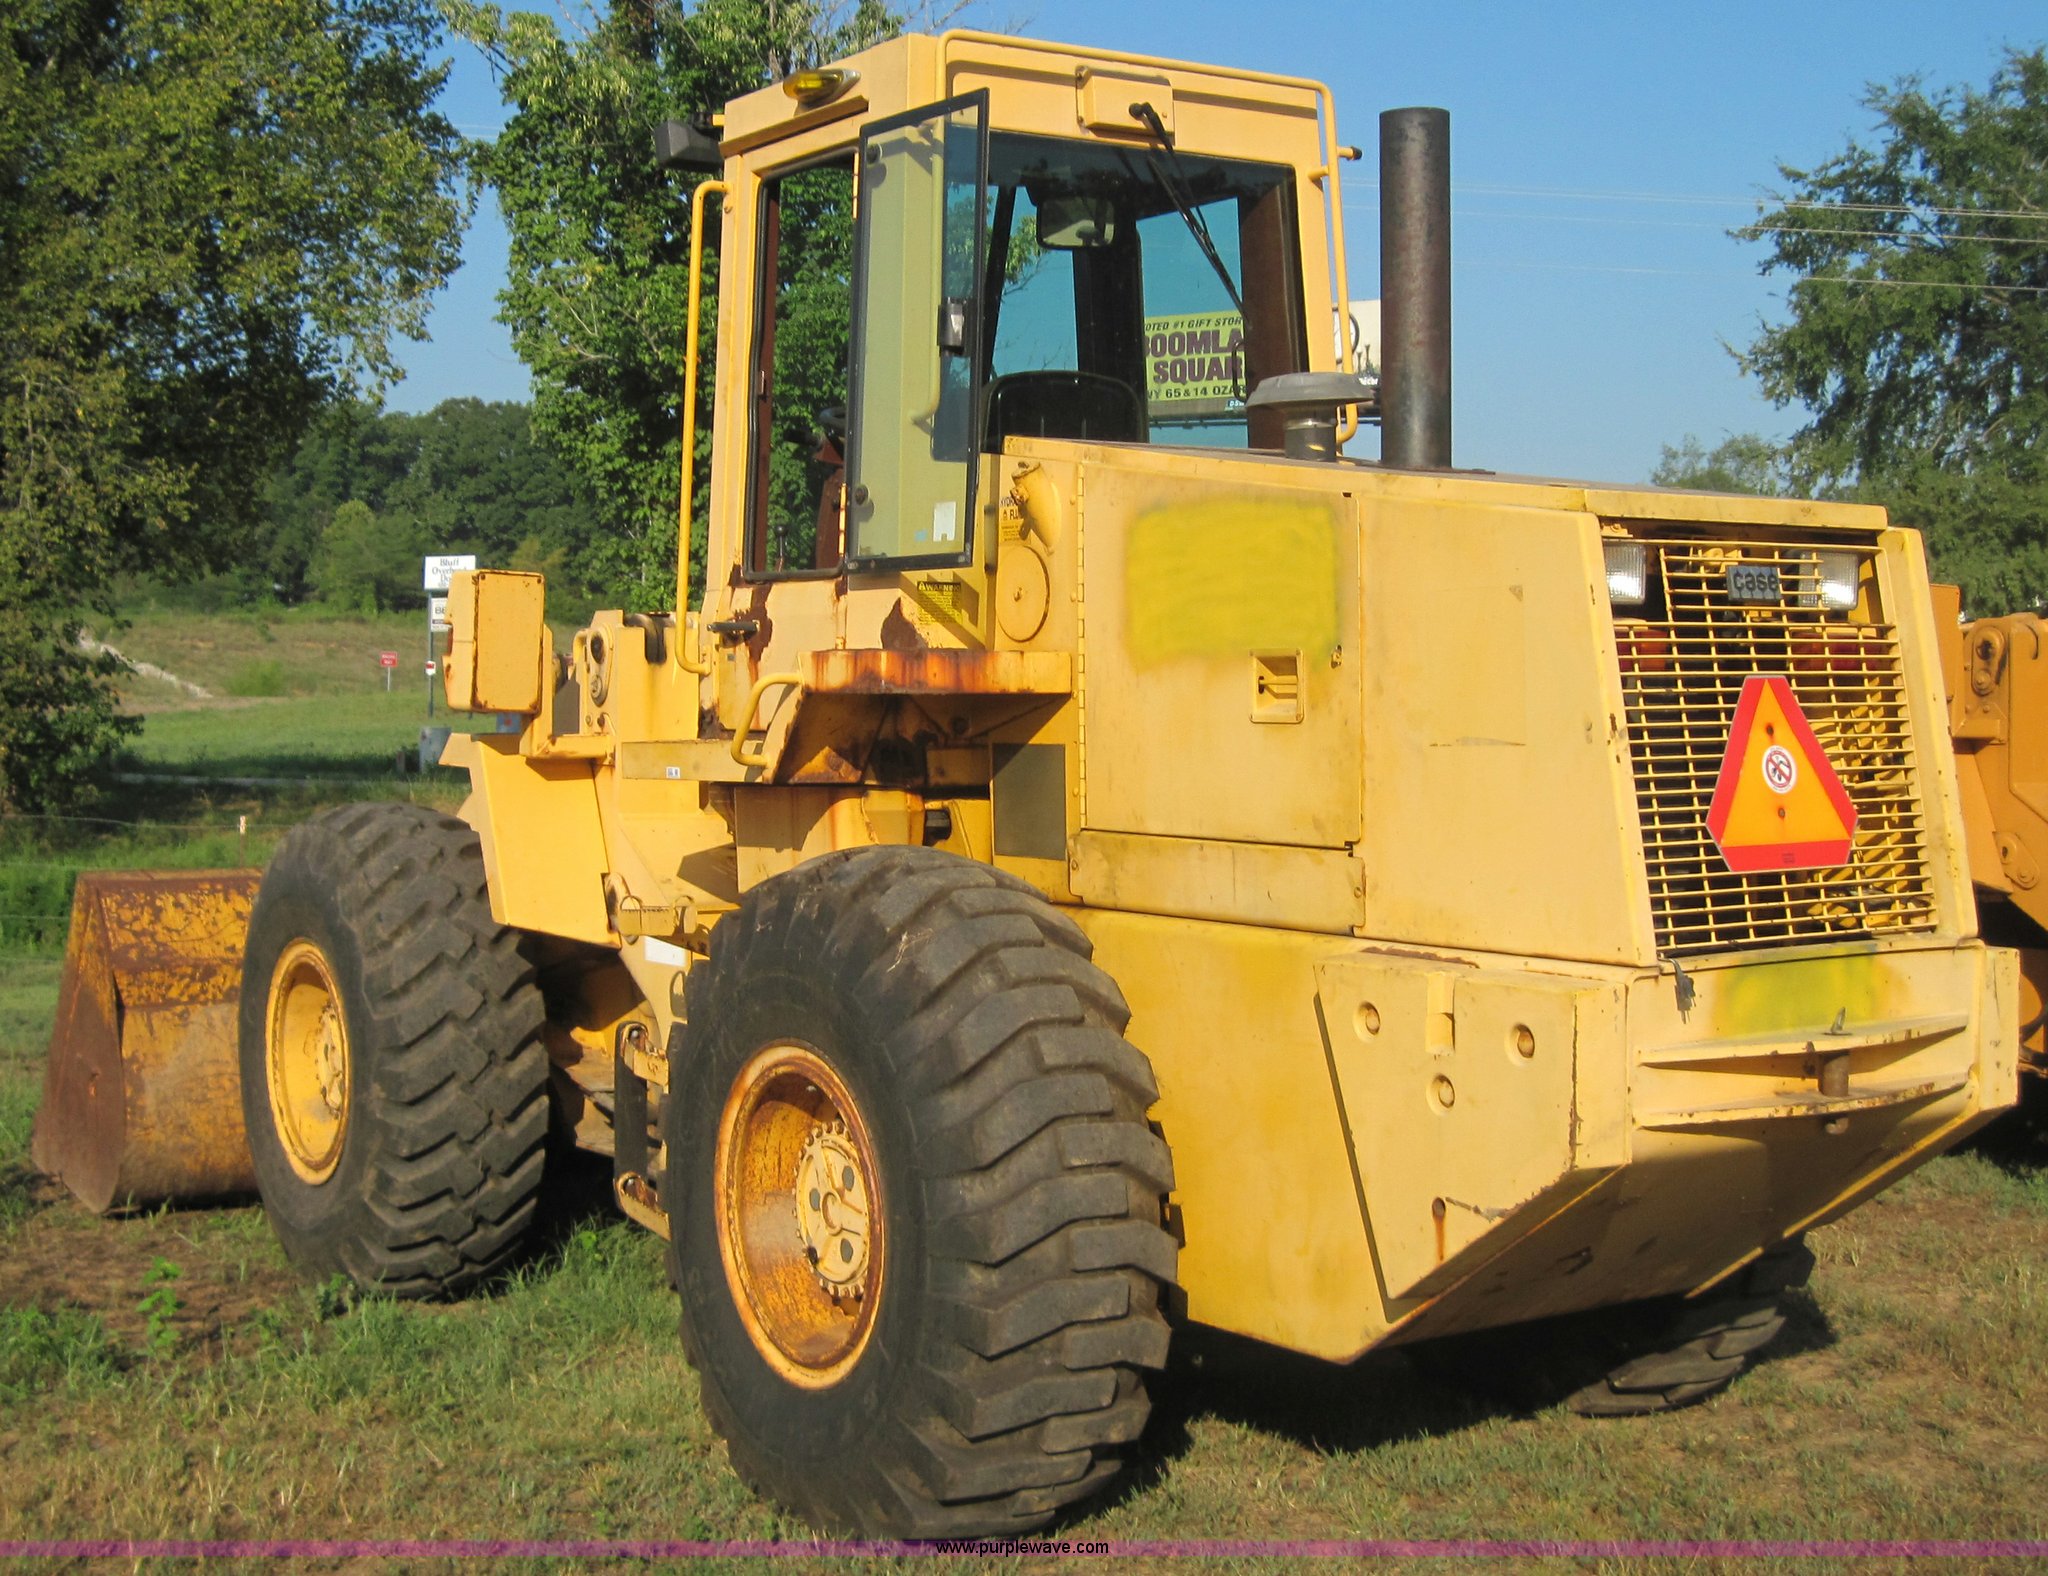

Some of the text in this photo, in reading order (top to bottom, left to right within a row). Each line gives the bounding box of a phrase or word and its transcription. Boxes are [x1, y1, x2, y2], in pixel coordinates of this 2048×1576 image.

[1145, 321, 1169, 331] OTED
[1187, 318, 1212, 329] GIFT
[1214, 316, 1242, 327] STOR
[1144, 328, 1245, 358] OOMLA
[1153, 355, 1243, 386] SQUAR
[1165, 388, 1182, 398] 65
[1194, 386, 1208, 397] 14
